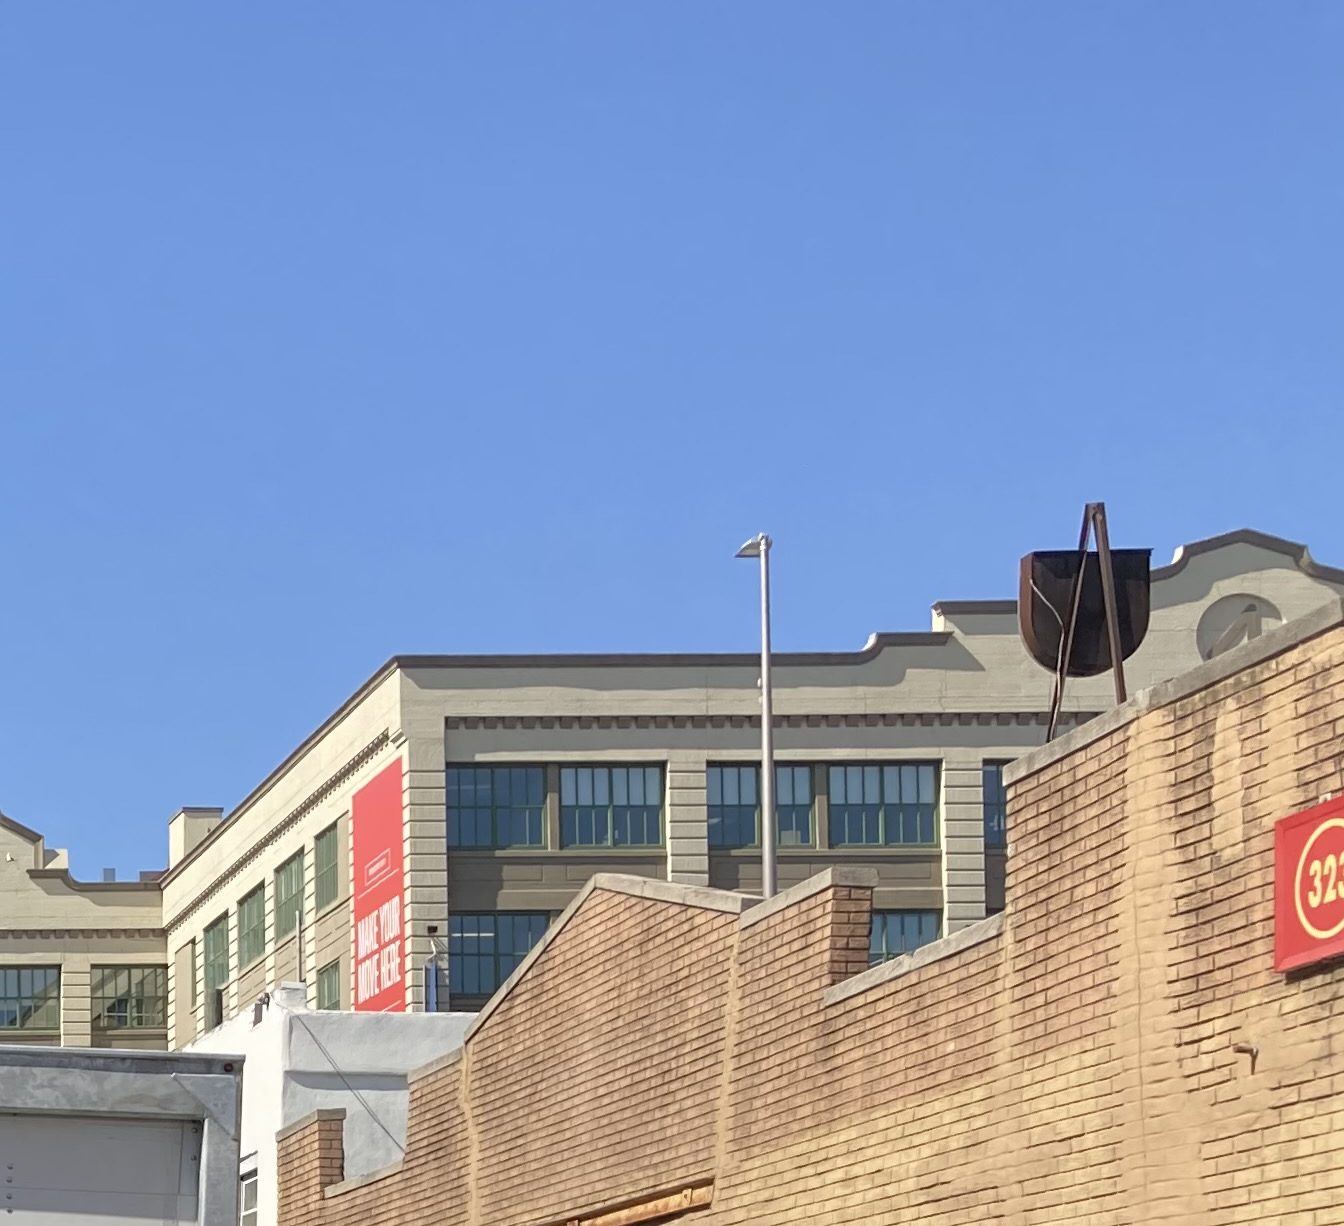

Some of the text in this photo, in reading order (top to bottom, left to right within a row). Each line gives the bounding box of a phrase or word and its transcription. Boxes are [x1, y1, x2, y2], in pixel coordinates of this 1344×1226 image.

[357, 895, 401, 961] MAKE YOUR
[357, 939, 402, 1005] MOVE HERE
